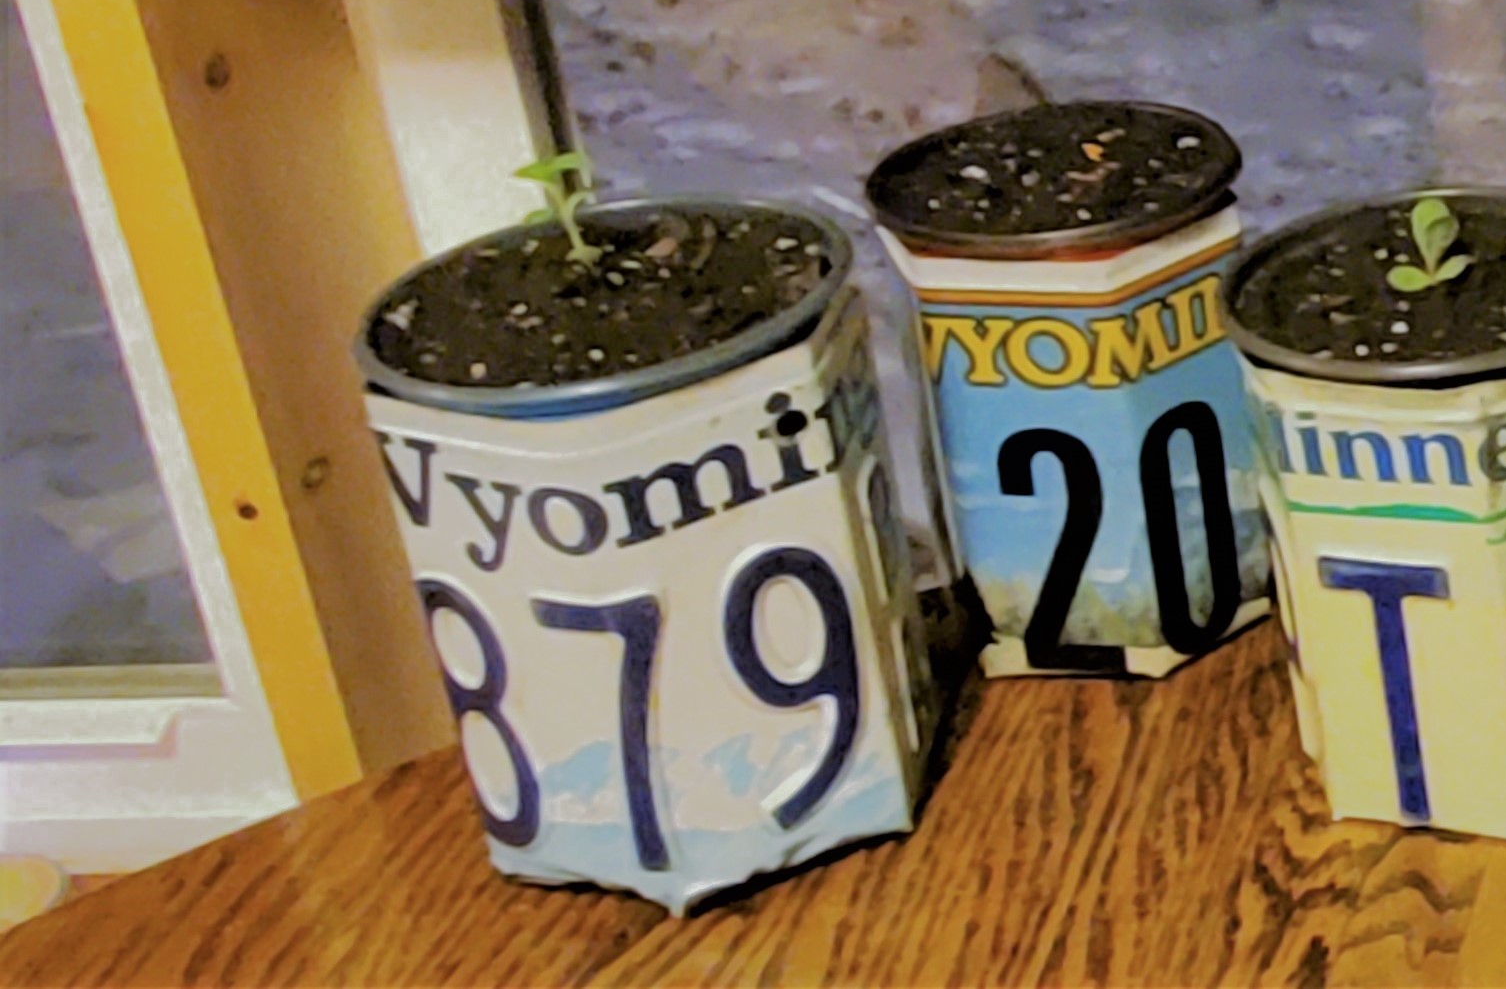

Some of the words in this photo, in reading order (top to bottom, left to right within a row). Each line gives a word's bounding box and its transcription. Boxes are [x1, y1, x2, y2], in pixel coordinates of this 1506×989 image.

[997, 400, 1243, 669] 20
[412, 546, 862, 872] 879
[1318, 555, 1451, 822] T
